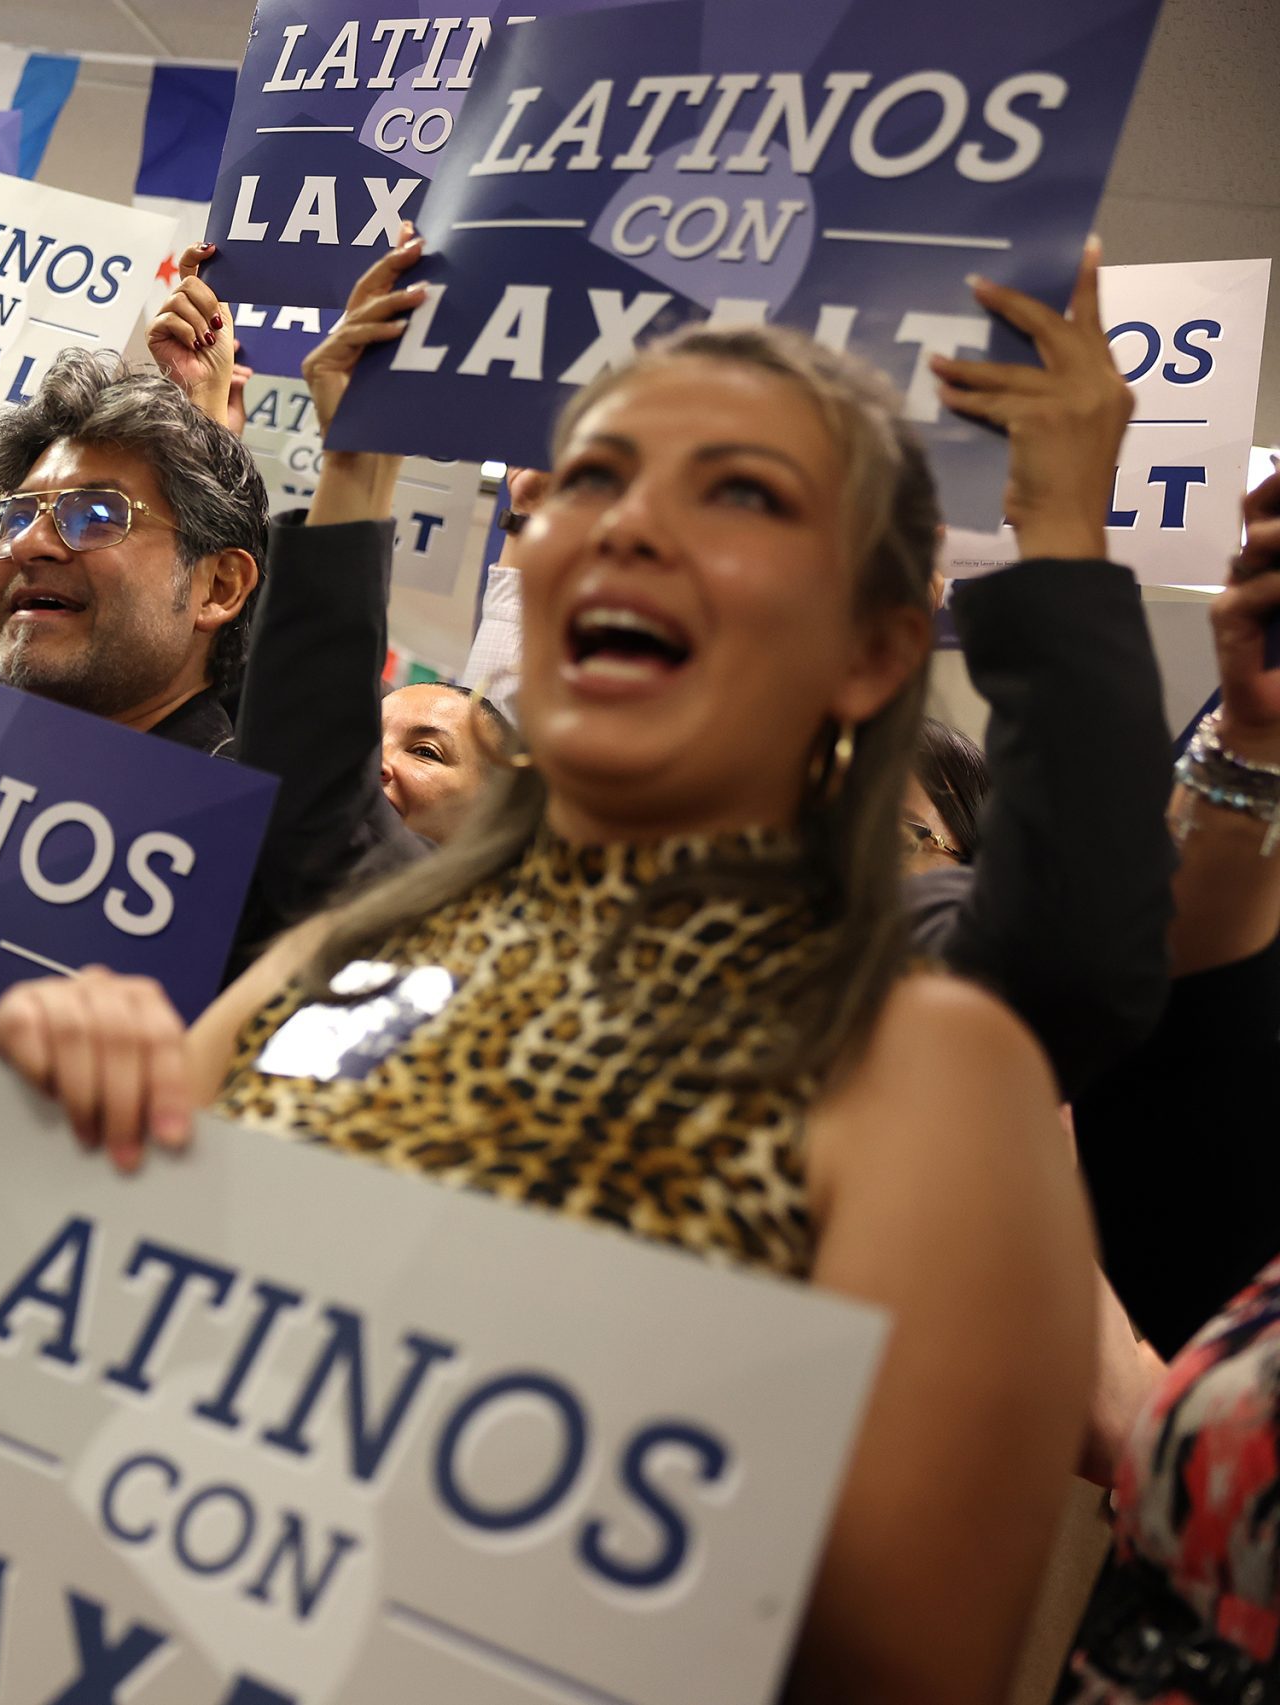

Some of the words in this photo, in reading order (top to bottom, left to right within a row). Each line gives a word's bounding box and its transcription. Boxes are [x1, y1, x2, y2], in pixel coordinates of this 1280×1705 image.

[262, 16, 537, 93] LATIN
[374, 107, 454, 153] CO
[469, 70, 1070, 184] LATINOS
[227, 175, 422, 247] LAX
[610, 194, 806, 263] CON
[389, 283, 992, 424] LAXT
[99, 1451, 362, 1622] CON
